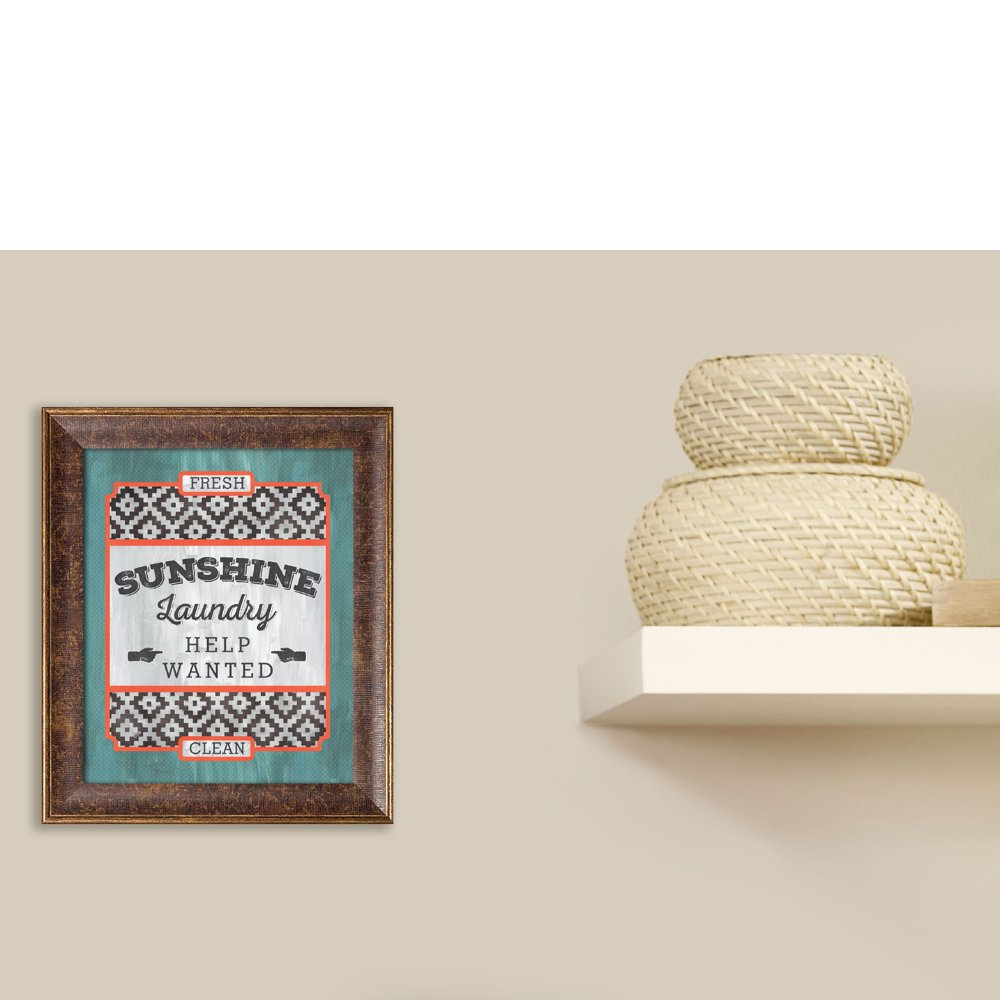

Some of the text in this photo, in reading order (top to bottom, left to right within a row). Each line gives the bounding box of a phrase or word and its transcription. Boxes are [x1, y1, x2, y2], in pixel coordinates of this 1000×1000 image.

[189, 476, 245, 490] FRESH
[114, 557, 322, 598] SUNSHINE
[155, 594, 277, 630] Laundry
[185, 637, 250, 653] HELP
[163, 662, 274, 679] WANTED
[189, 741, 245, 755] CLEAN
